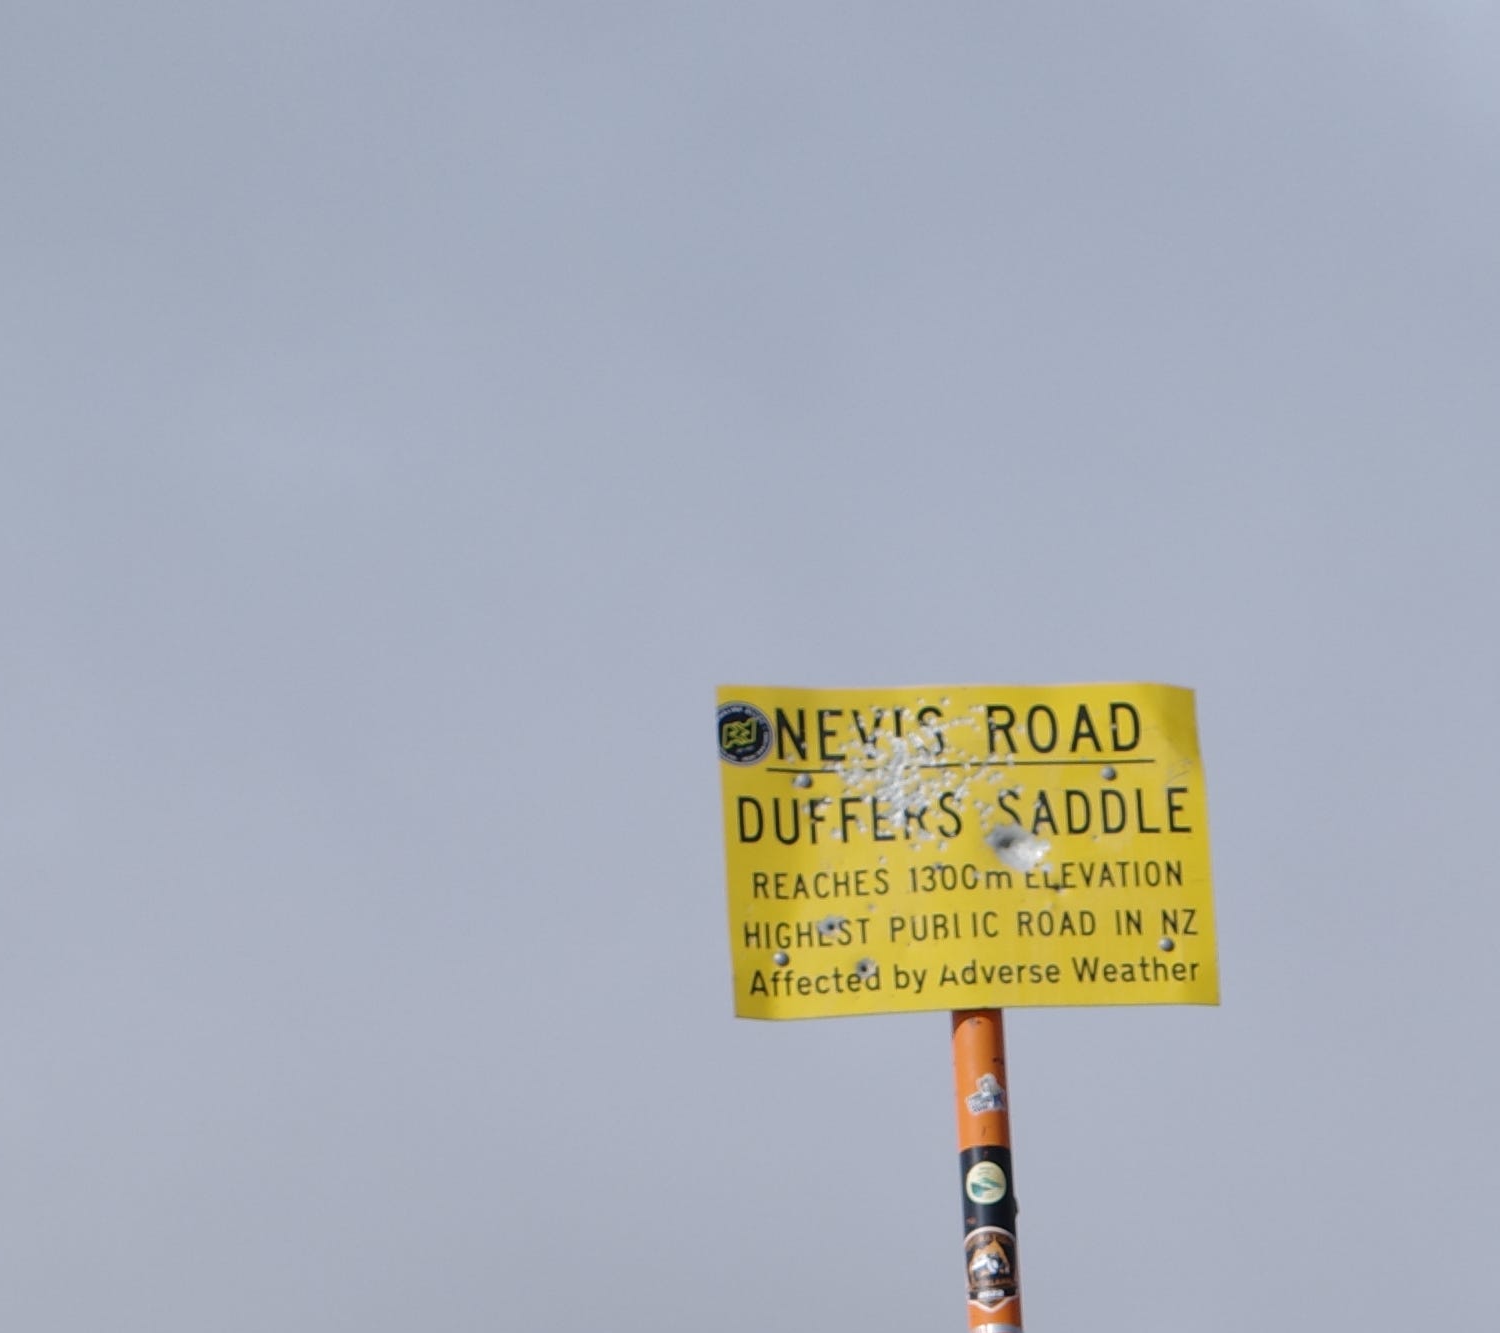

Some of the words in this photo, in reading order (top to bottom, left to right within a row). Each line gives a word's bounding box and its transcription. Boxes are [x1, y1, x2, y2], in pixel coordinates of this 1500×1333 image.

[775, 706, 945, 761] NEVIS
[987, 702, 1140, 753] ROAD
[738, 791, 962, 845] DUFFERS
[998, 786, 1192, 836] SADDLE
[753, 868, 890, 899] REACHES
[910, 864, 1012, 893] 1300m
[1025, 860, 1183, 889] ELEVATION
[743, 918, 870, 949] HIGHEST
[890, 911, 998, 942] PUBLIC
[1017, 910, 1096, 936] ROAD
[1115, 909, 1142, 935] IN
[1161, 908, 1199, 936] NZ
[750, 966, 881, 996] Affected
[894, 964, 927, 993] by
[939, 960, 1061, 986] Adverse
[1071, 956, 1200, 983] Weather
